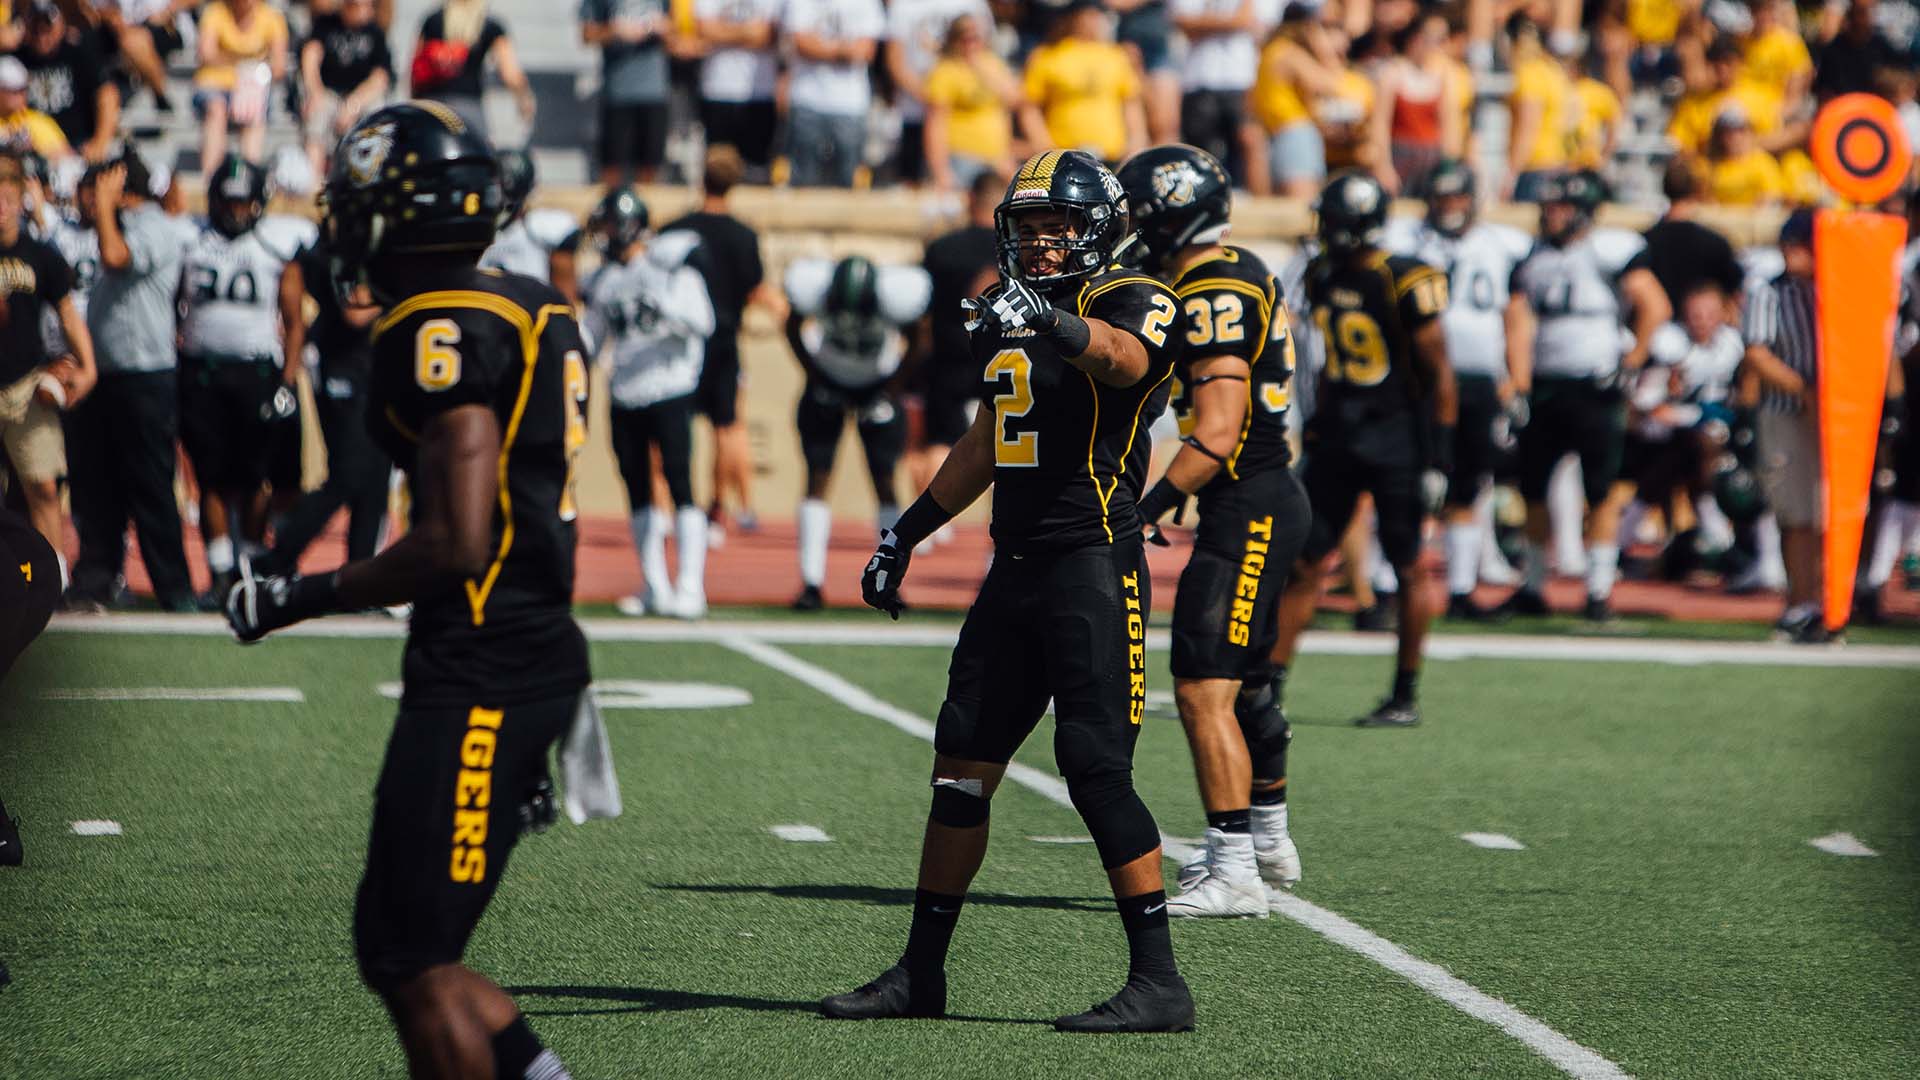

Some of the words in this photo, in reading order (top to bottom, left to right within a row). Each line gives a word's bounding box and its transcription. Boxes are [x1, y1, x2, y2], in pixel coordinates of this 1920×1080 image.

[463, 192, 480, 216] 6
[415, 318, 461, 392] 6
[1141, 294, 1177, 347] 2
[1185, 294, 1245, 346] 32
[1313, 306, 1391, 386] 19
[984, 348, 1039, 467] 2
[1228, 515, 1273, 647] TIGERS
[1122, 570, 1145, 725] TIGERS
[450, 704, 504, 883] IGERS
